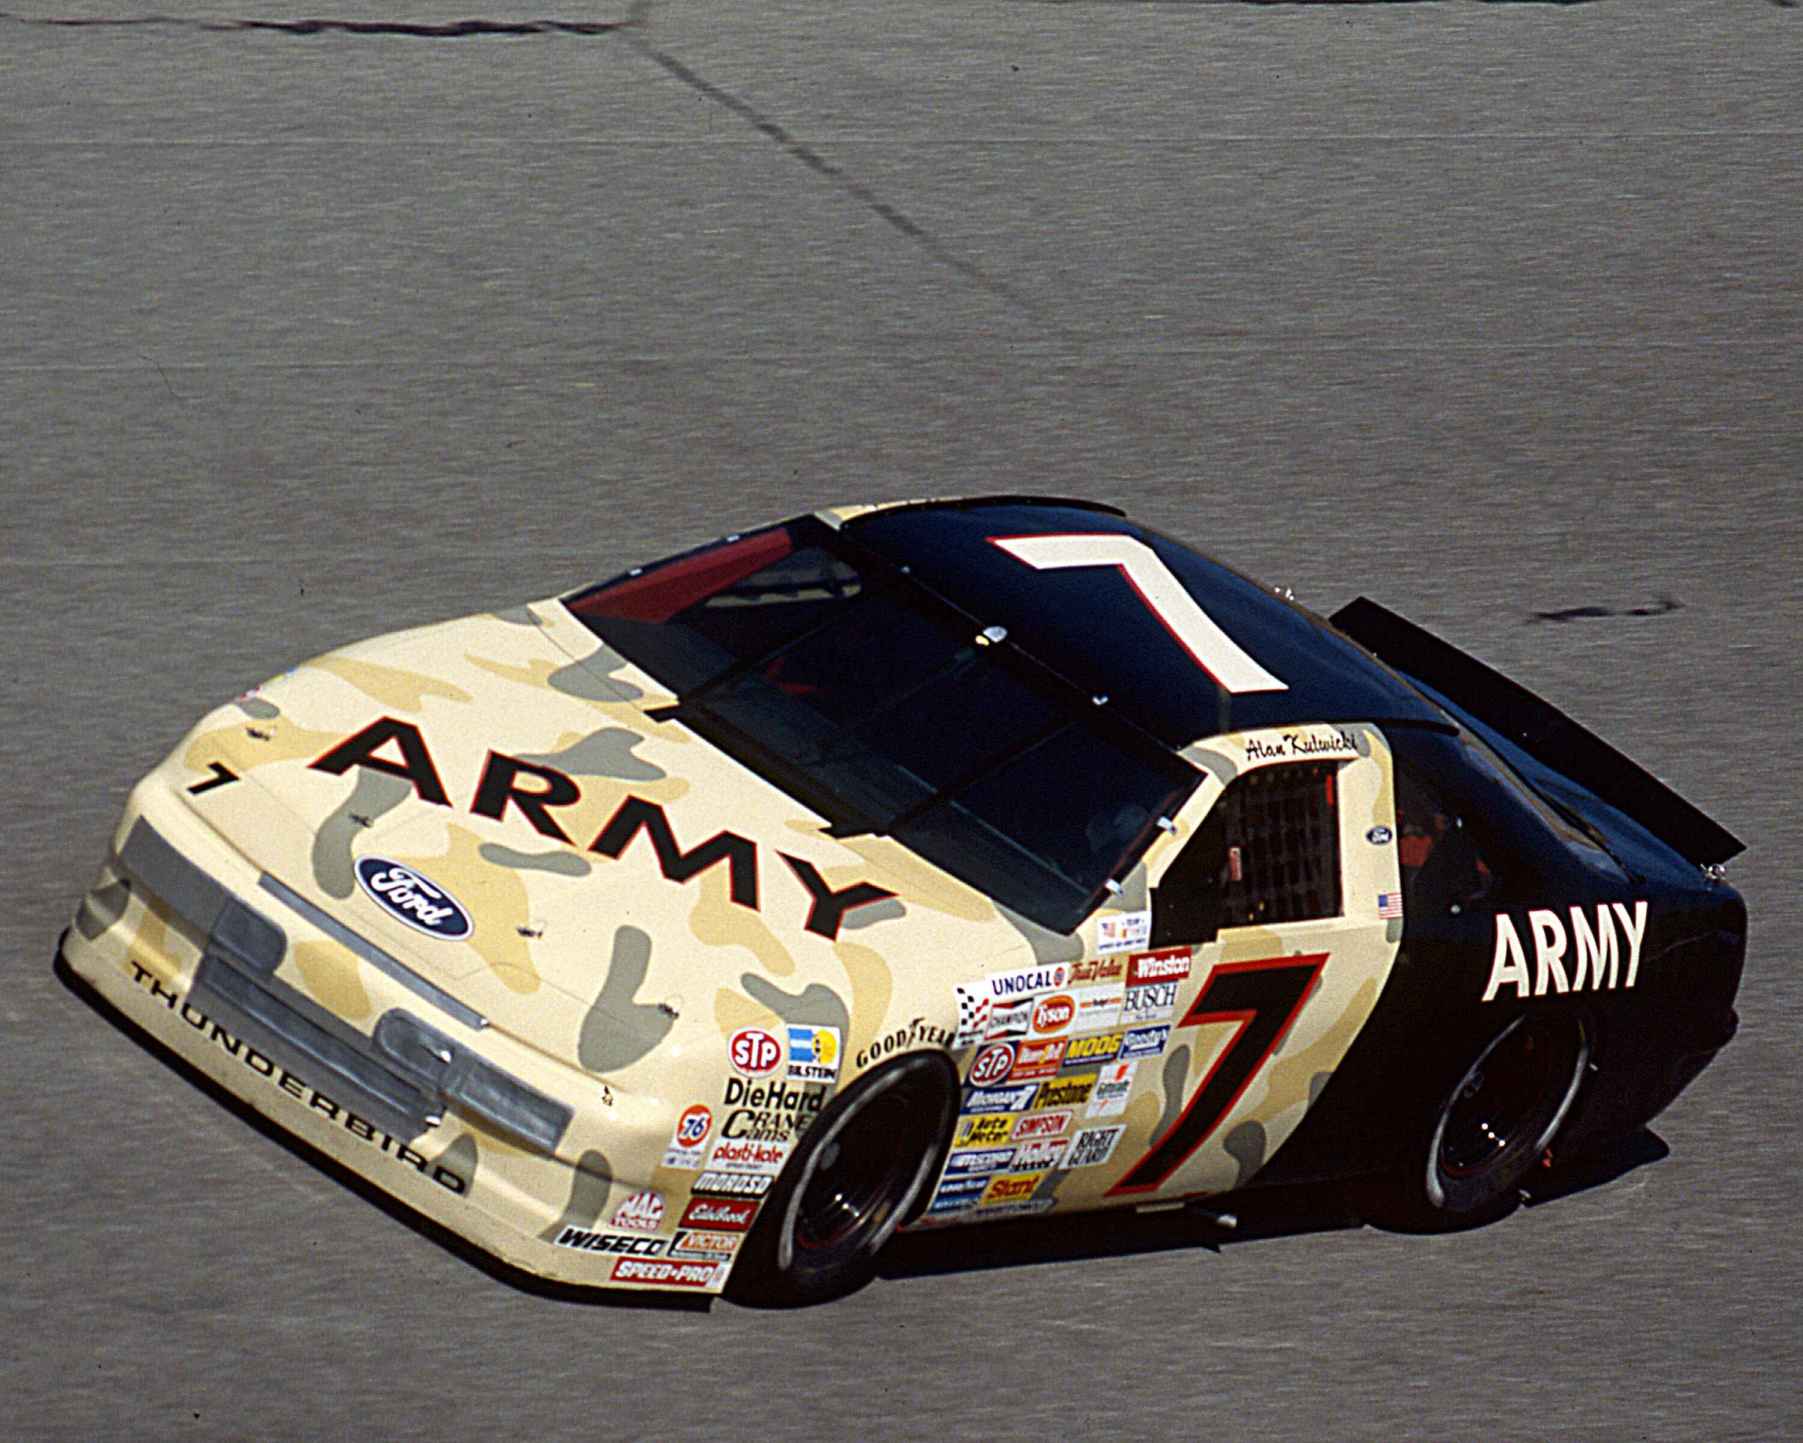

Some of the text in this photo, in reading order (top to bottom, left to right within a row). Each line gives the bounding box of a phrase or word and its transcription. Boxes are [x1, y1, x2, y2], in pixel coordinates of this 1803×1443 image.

[984, 532, 1290, 693] 7
[1246, 739, 1286, 761] Alan
[186, 761, 239, 795] 7
[308, 715, 897, 941] ARMY
[371, 867, 454, 925] Ford
[1481, 901, 1648, 1002] ARMY
[1137, 955, 1190, 978] Winston
[991, 970, 1052, 995] UNOCAL
[1123, 983, 1177, 1012] BUSCH
[1037, 1003, 1070, 1028] Tyson
[735, 1032, 777, 1068] STP
[856, 1017, 956, 1068] GOODYEAR
[1069, 1034, 1122, 1058] MOOG
[131, 960, 467, 1194] THUNDERBIRD
[787, 1065, 836, 1080] BILSTEIN
[974, 1047, 1009, 1078] STP
[1103, 952, 1330, 1198] 7
[723, 1077, 827, 1112] DieHard
[1034, 1081, 1093, 1109] Prestone
[683, 1116, 706, 1138] 76
[1016, 1115, 1066, 1137] SIMPSON
[619, 1190, 665, 1218] MAC
[559, 1228, 669, 1256] WISECO
